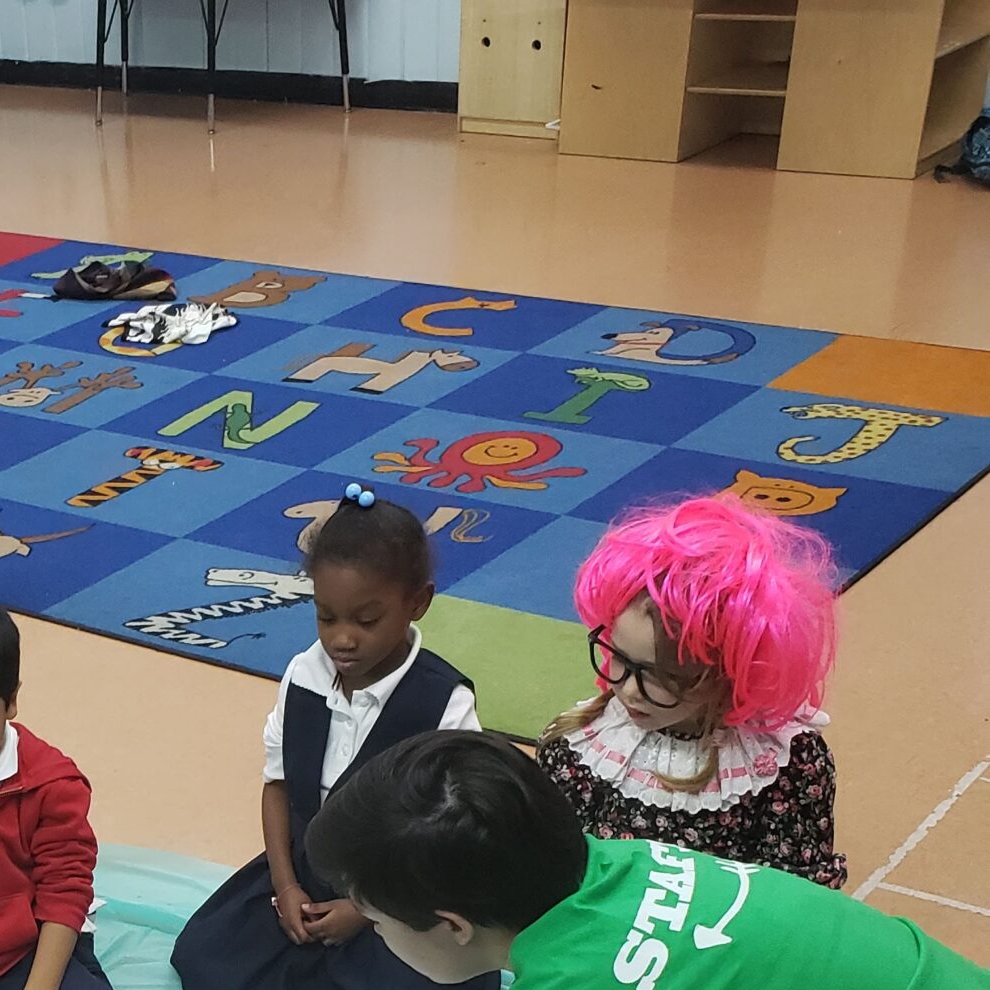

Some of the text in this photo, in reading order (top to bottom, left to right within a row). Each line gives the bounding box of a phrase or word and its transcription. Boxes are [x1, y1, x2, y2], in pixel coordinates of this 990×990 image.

[399, 296, 517, 337] C
[587, 318, 757, 366] D
[156, 390, 322, 450] N
[282, 342, 481, 394] H
[776, 403, 949, 464] J
[65, 446, 224, 508] T
